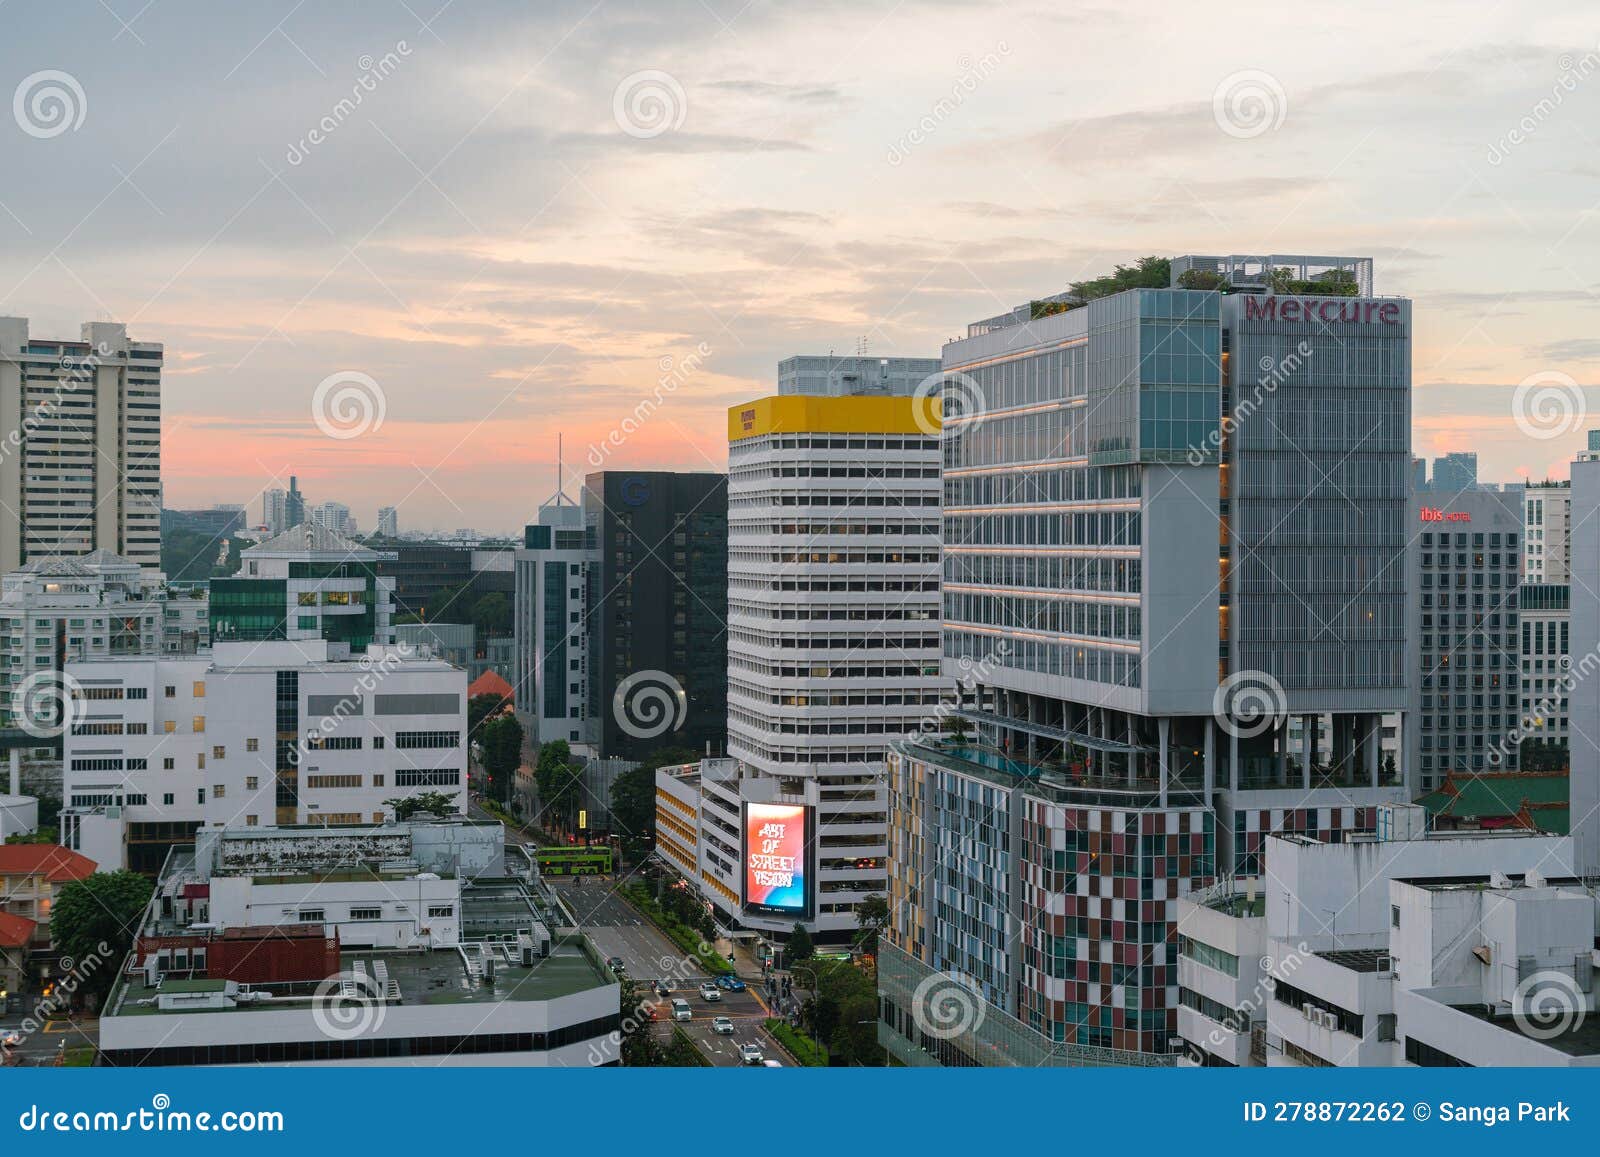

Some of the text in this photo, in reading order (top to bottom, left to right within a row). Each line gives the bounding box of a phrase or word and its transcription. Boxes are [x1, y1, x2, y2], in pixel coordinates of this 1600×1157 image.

[1245, 295, 1401, 325] Mercure
[1420, 506, 1472, 522] ibis HOTEL
[762, 839, 780, 854] OF
[749, 853, 796, 872] STREET
